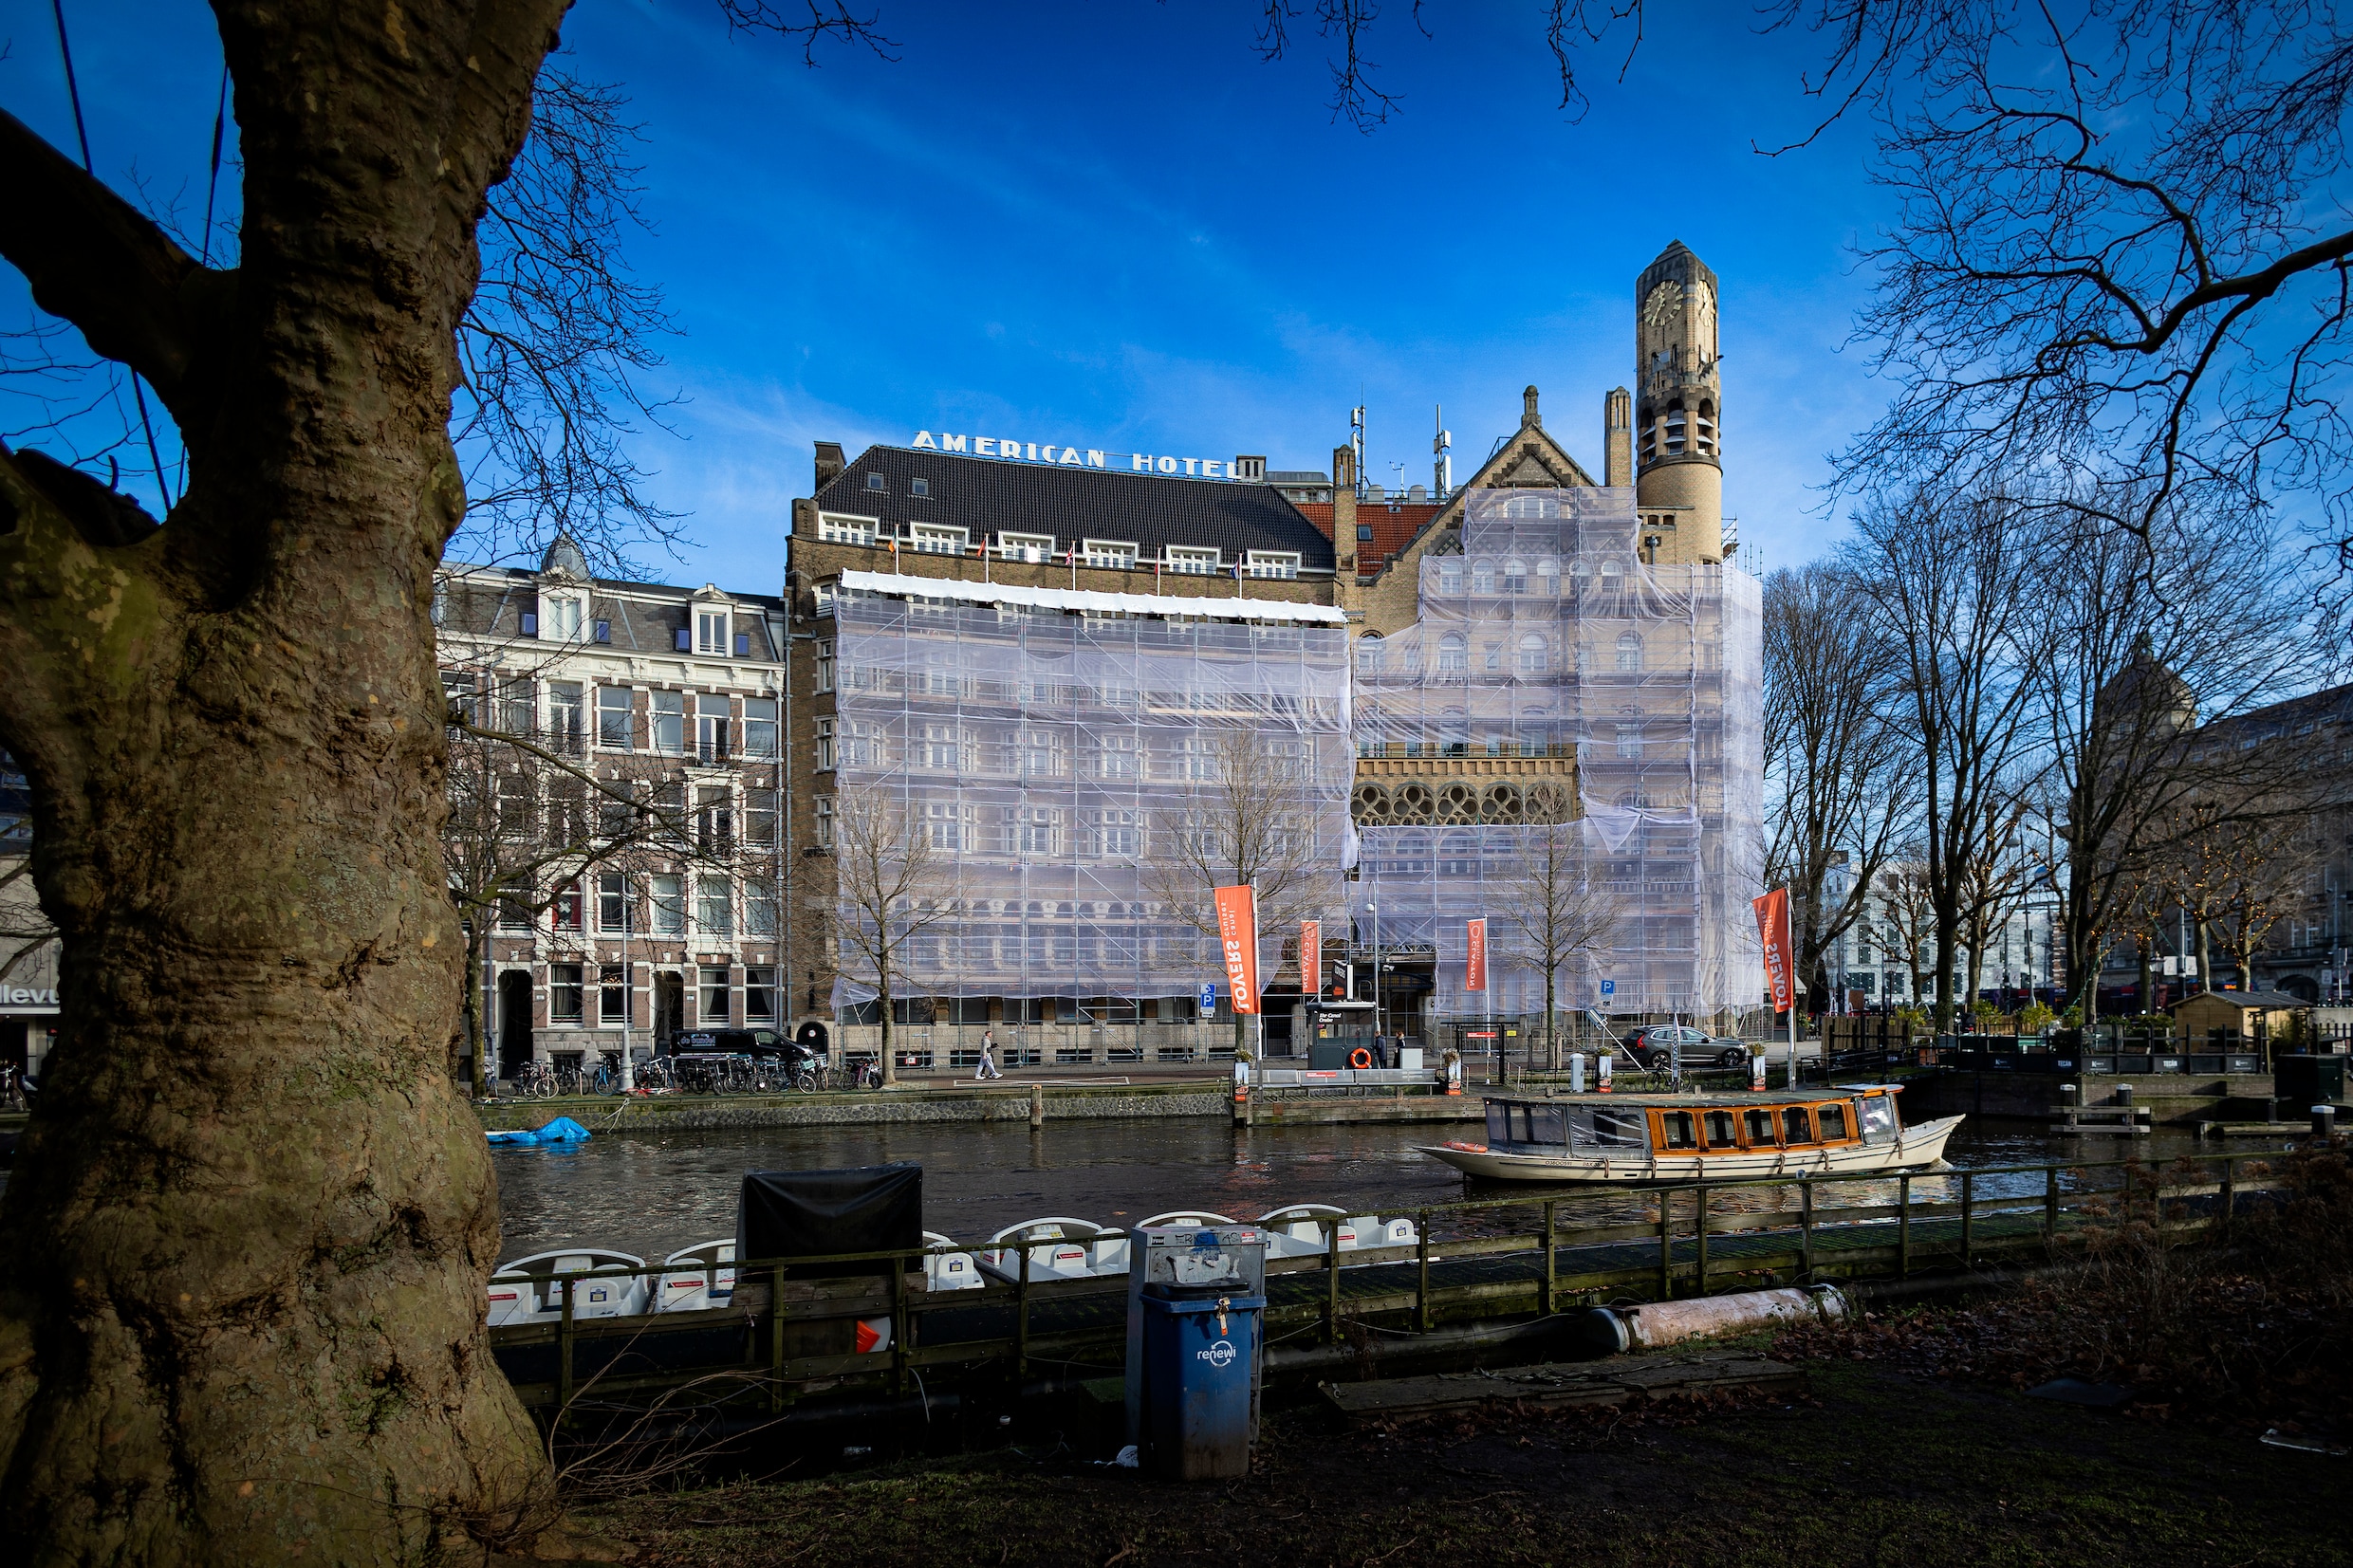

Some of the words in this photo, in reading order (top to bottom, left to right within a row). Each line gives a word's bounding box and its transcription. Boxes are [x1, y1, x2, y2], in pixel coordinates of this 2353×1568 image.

[912, 430, 1104, 468] AMERICAN
[1133, 452, 1242, 480] HOTEL
[1603, 981, 1612, 992] P
[1203, 994, 1213, 1006] P
[1196, 1345, 1236, 1362] renewi
